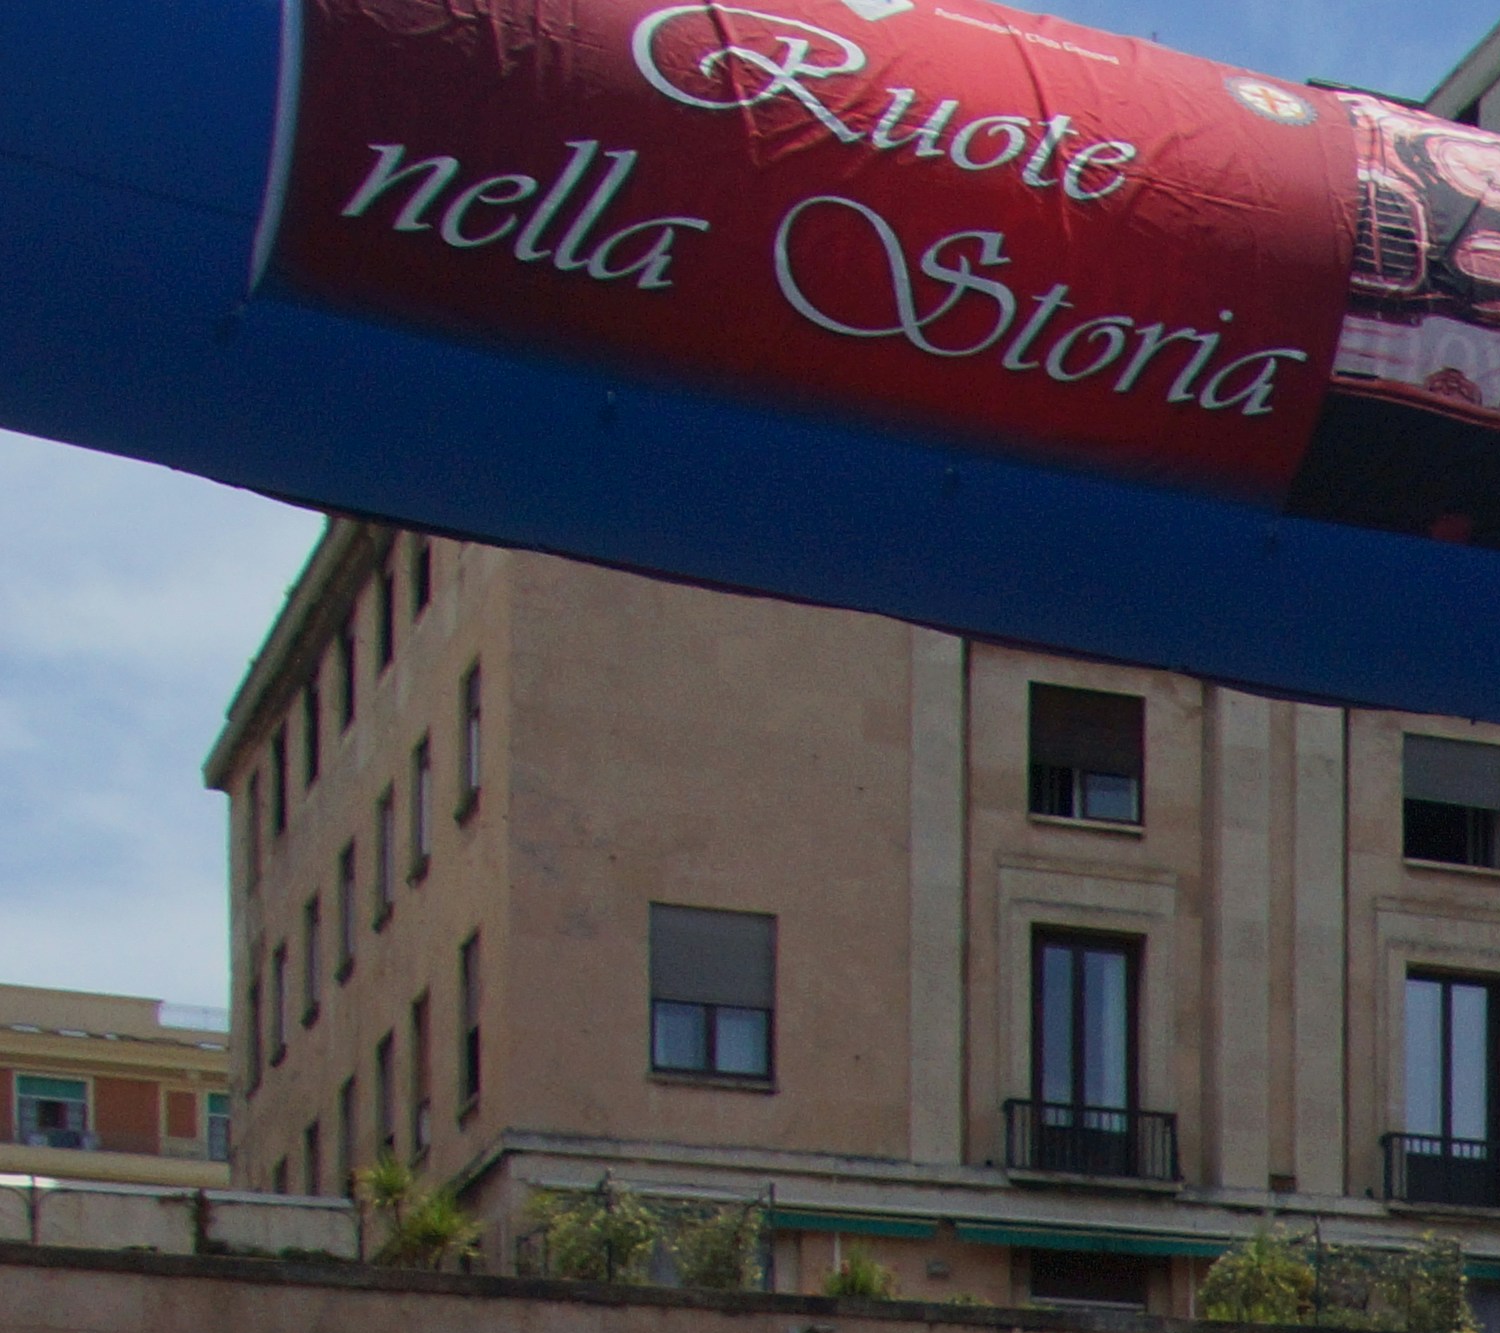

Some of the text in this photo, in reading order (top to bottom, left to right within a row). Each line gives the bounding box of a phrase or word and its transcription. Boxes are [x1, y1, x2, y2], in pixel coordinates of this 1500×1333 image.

[632, 3, 1137, 200] Ruote
[341, 139, 711, 289] nella
[774, 195, 1308, 416] Storia
